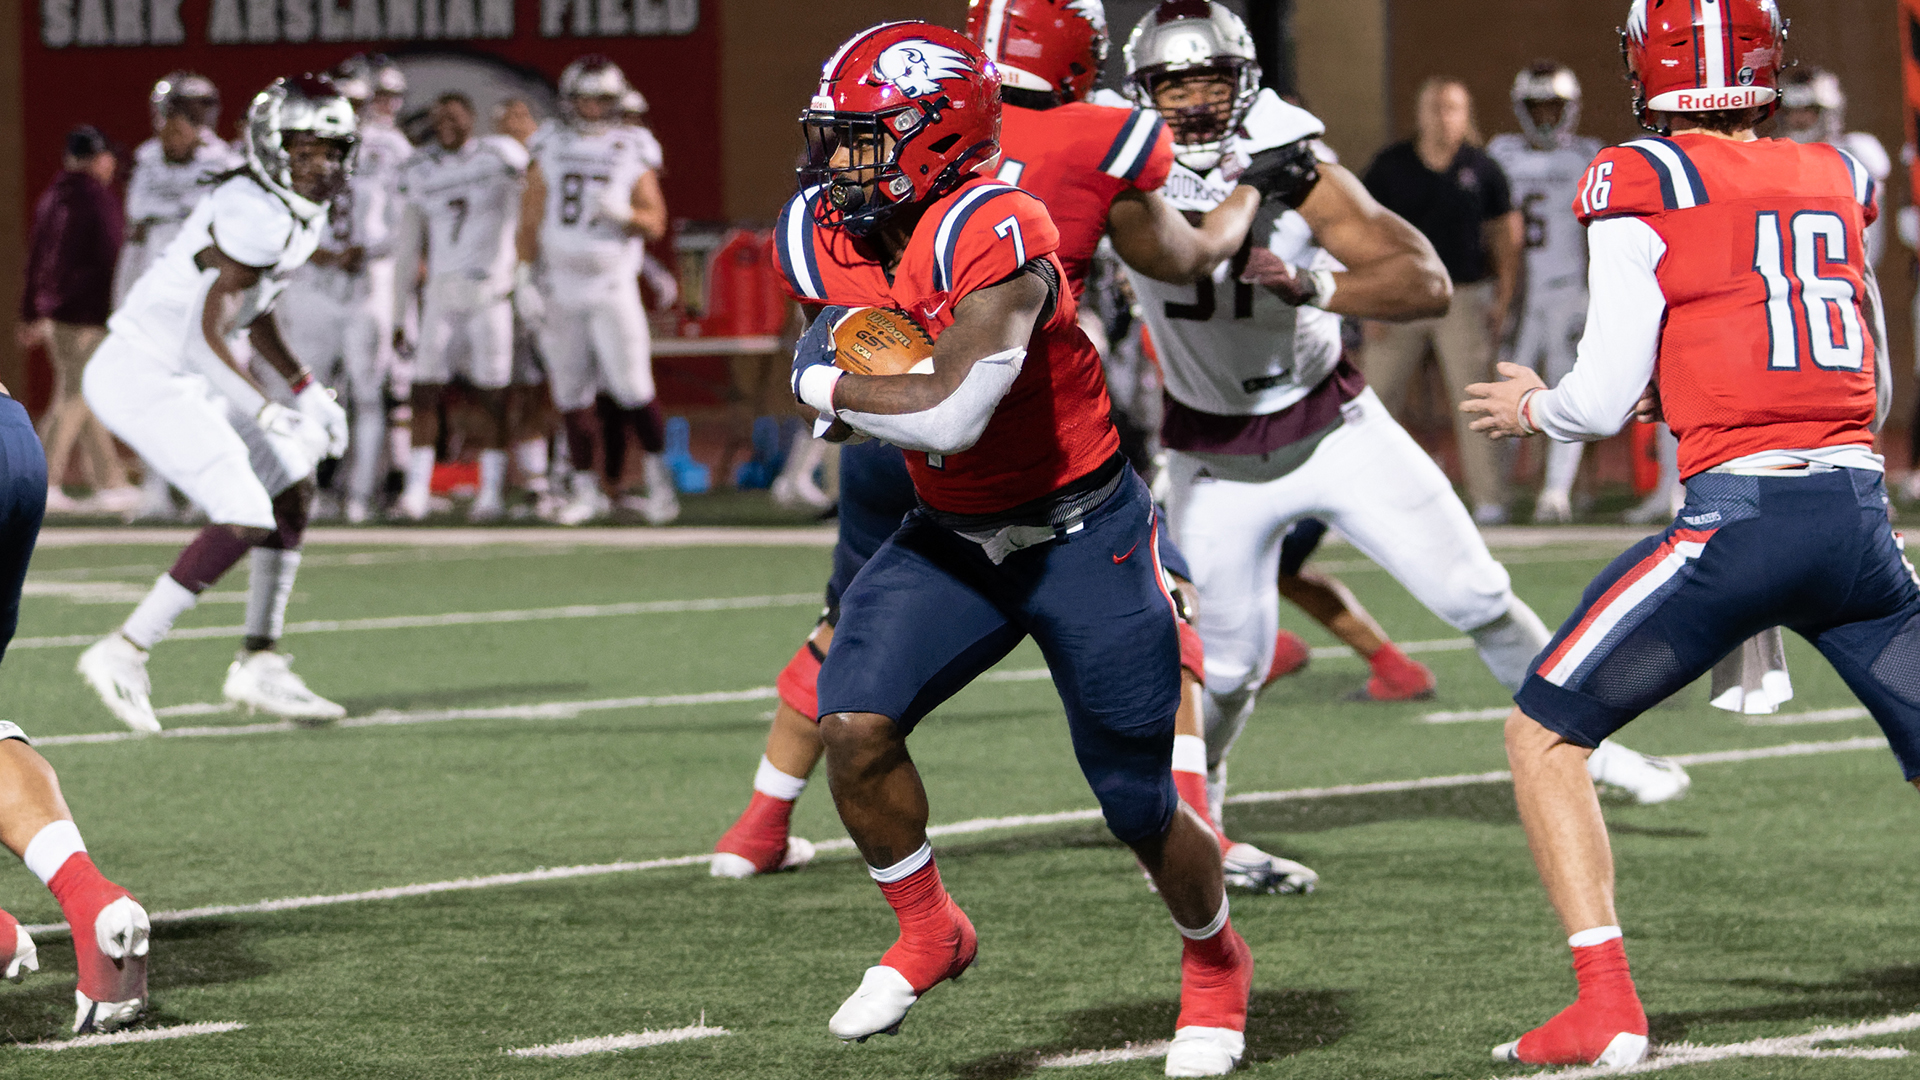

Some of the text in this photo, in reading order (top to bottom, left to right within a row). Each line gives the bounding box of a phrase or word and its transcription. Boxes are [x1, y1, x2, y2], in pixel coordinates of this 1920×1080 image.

[41, 0, 699, 48] SARK ARSLANIAN FIELD
[1677, 90, 1756, 110] Riddell
[1580, 160, 1614, 216] 16
[447, 197, 469, 242] 7
[993, 213, 1026, 271] 7
[1751, 209, 1865, 373] 16
[851, 343, 873, 360] NCAA
[855, 330, 890, 351] GST
[865, 311, 912, 350] Wilson
